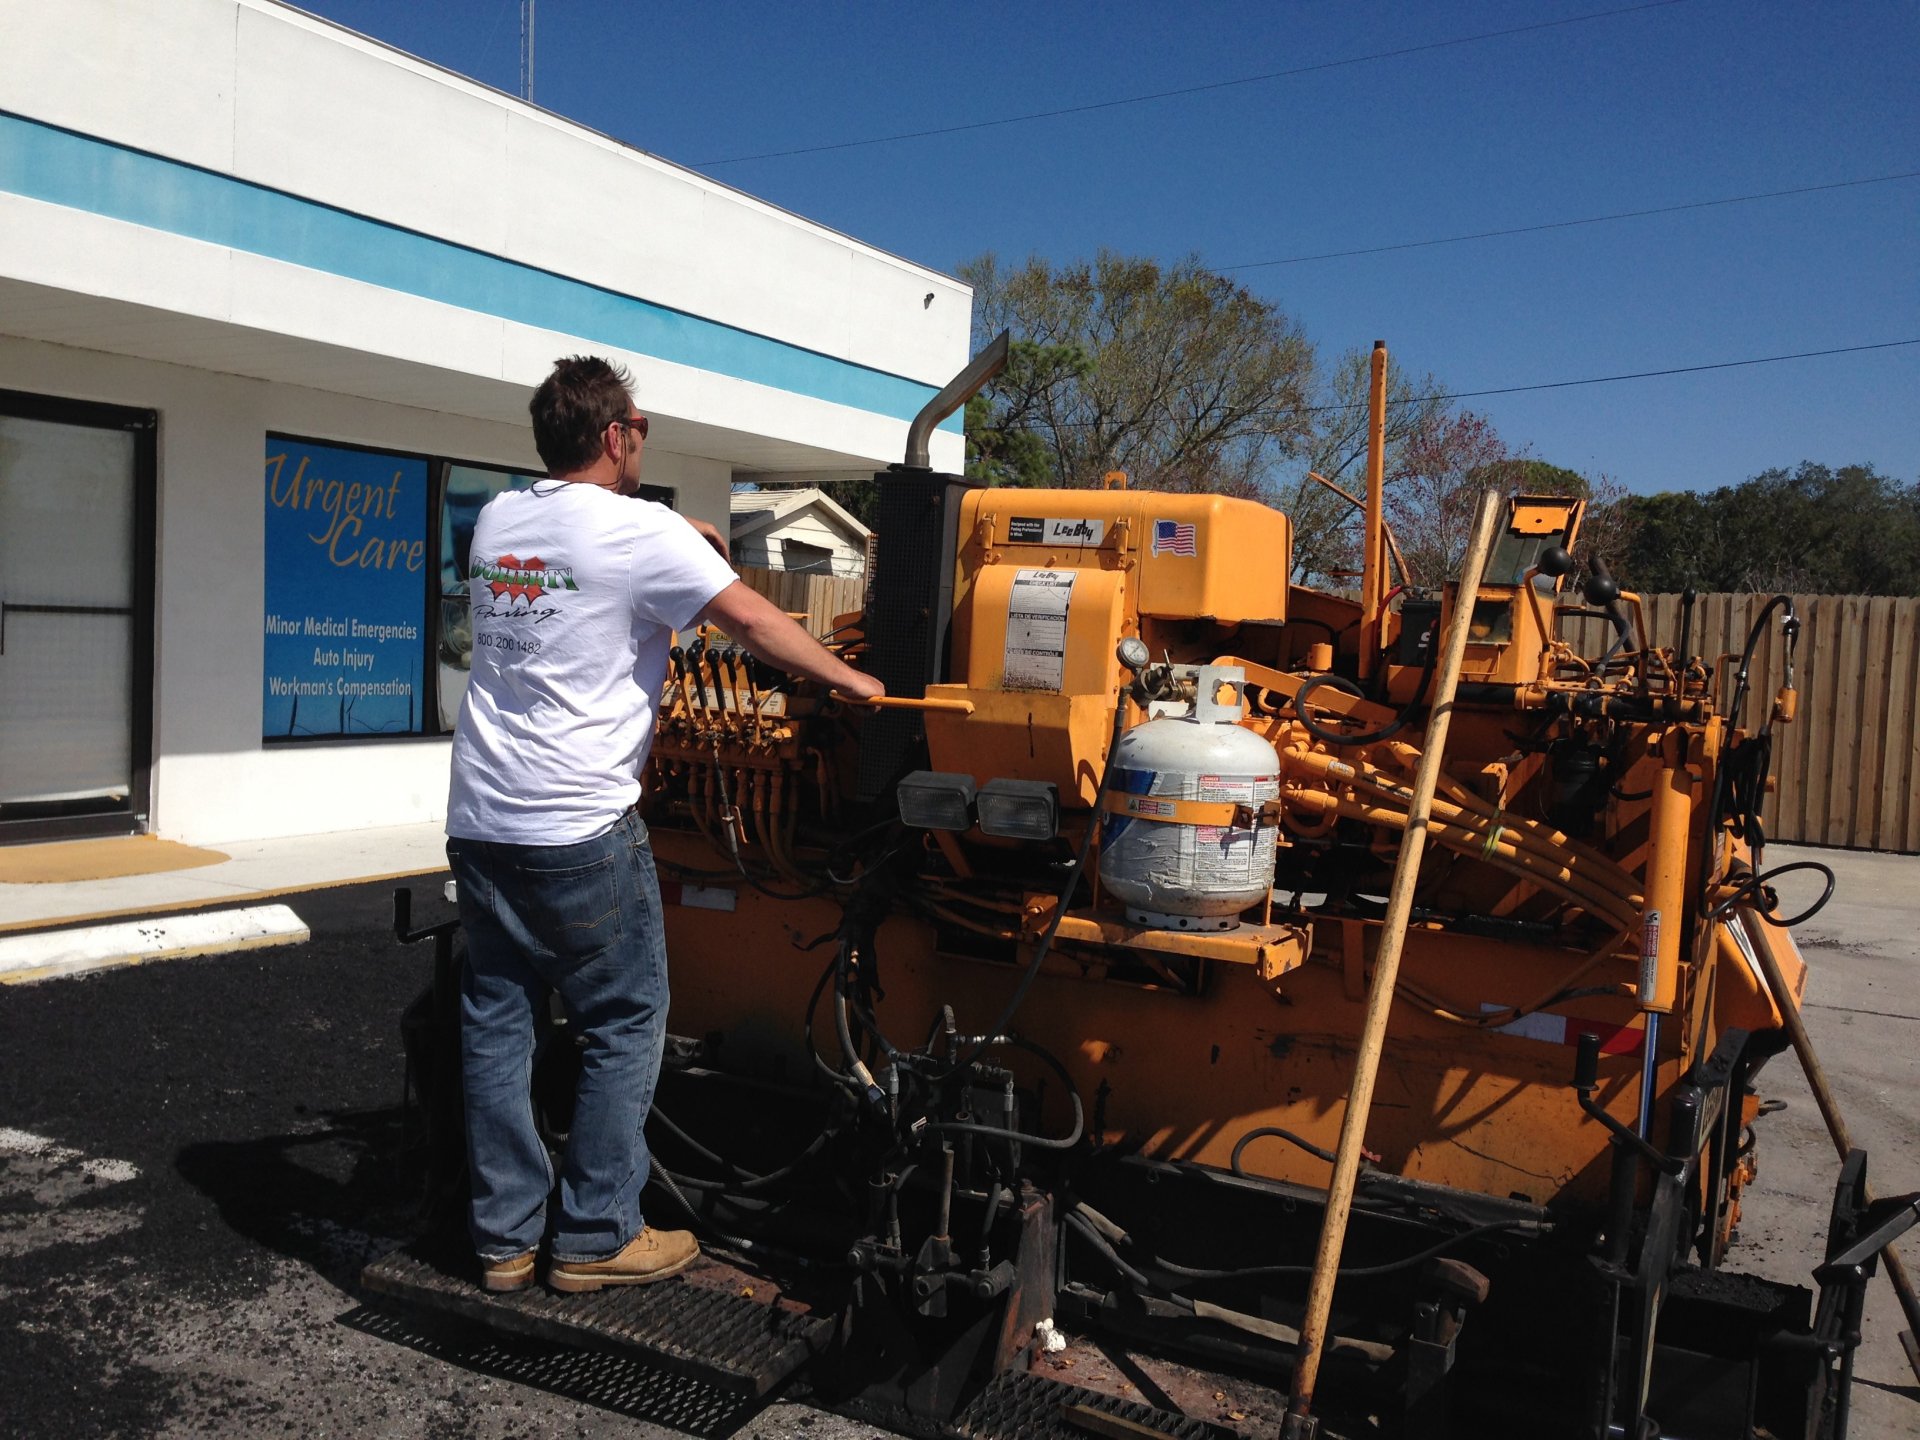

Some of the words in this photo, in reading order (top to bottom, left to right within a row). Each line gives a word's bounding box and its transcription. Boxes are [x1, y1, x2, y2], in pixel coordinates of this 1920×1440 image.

[266, 453, 402, 544] Urgent
[329, 514, 424, 572] Care
[1053, 522, 1094, 541] LeeBoy
[470, 555, 580, 592] DOHERTY
[265, 615, 301, 635] Minor
[304, 616, 348, 637] Medical
[351, 619, 417, 643] Emergencies
[313, 647, 340, 666] Auto
[343, 648, 375, 672] Injury
[269, 676, 333, 697] Workman's
[336, 677, 412, 699] Compensation
